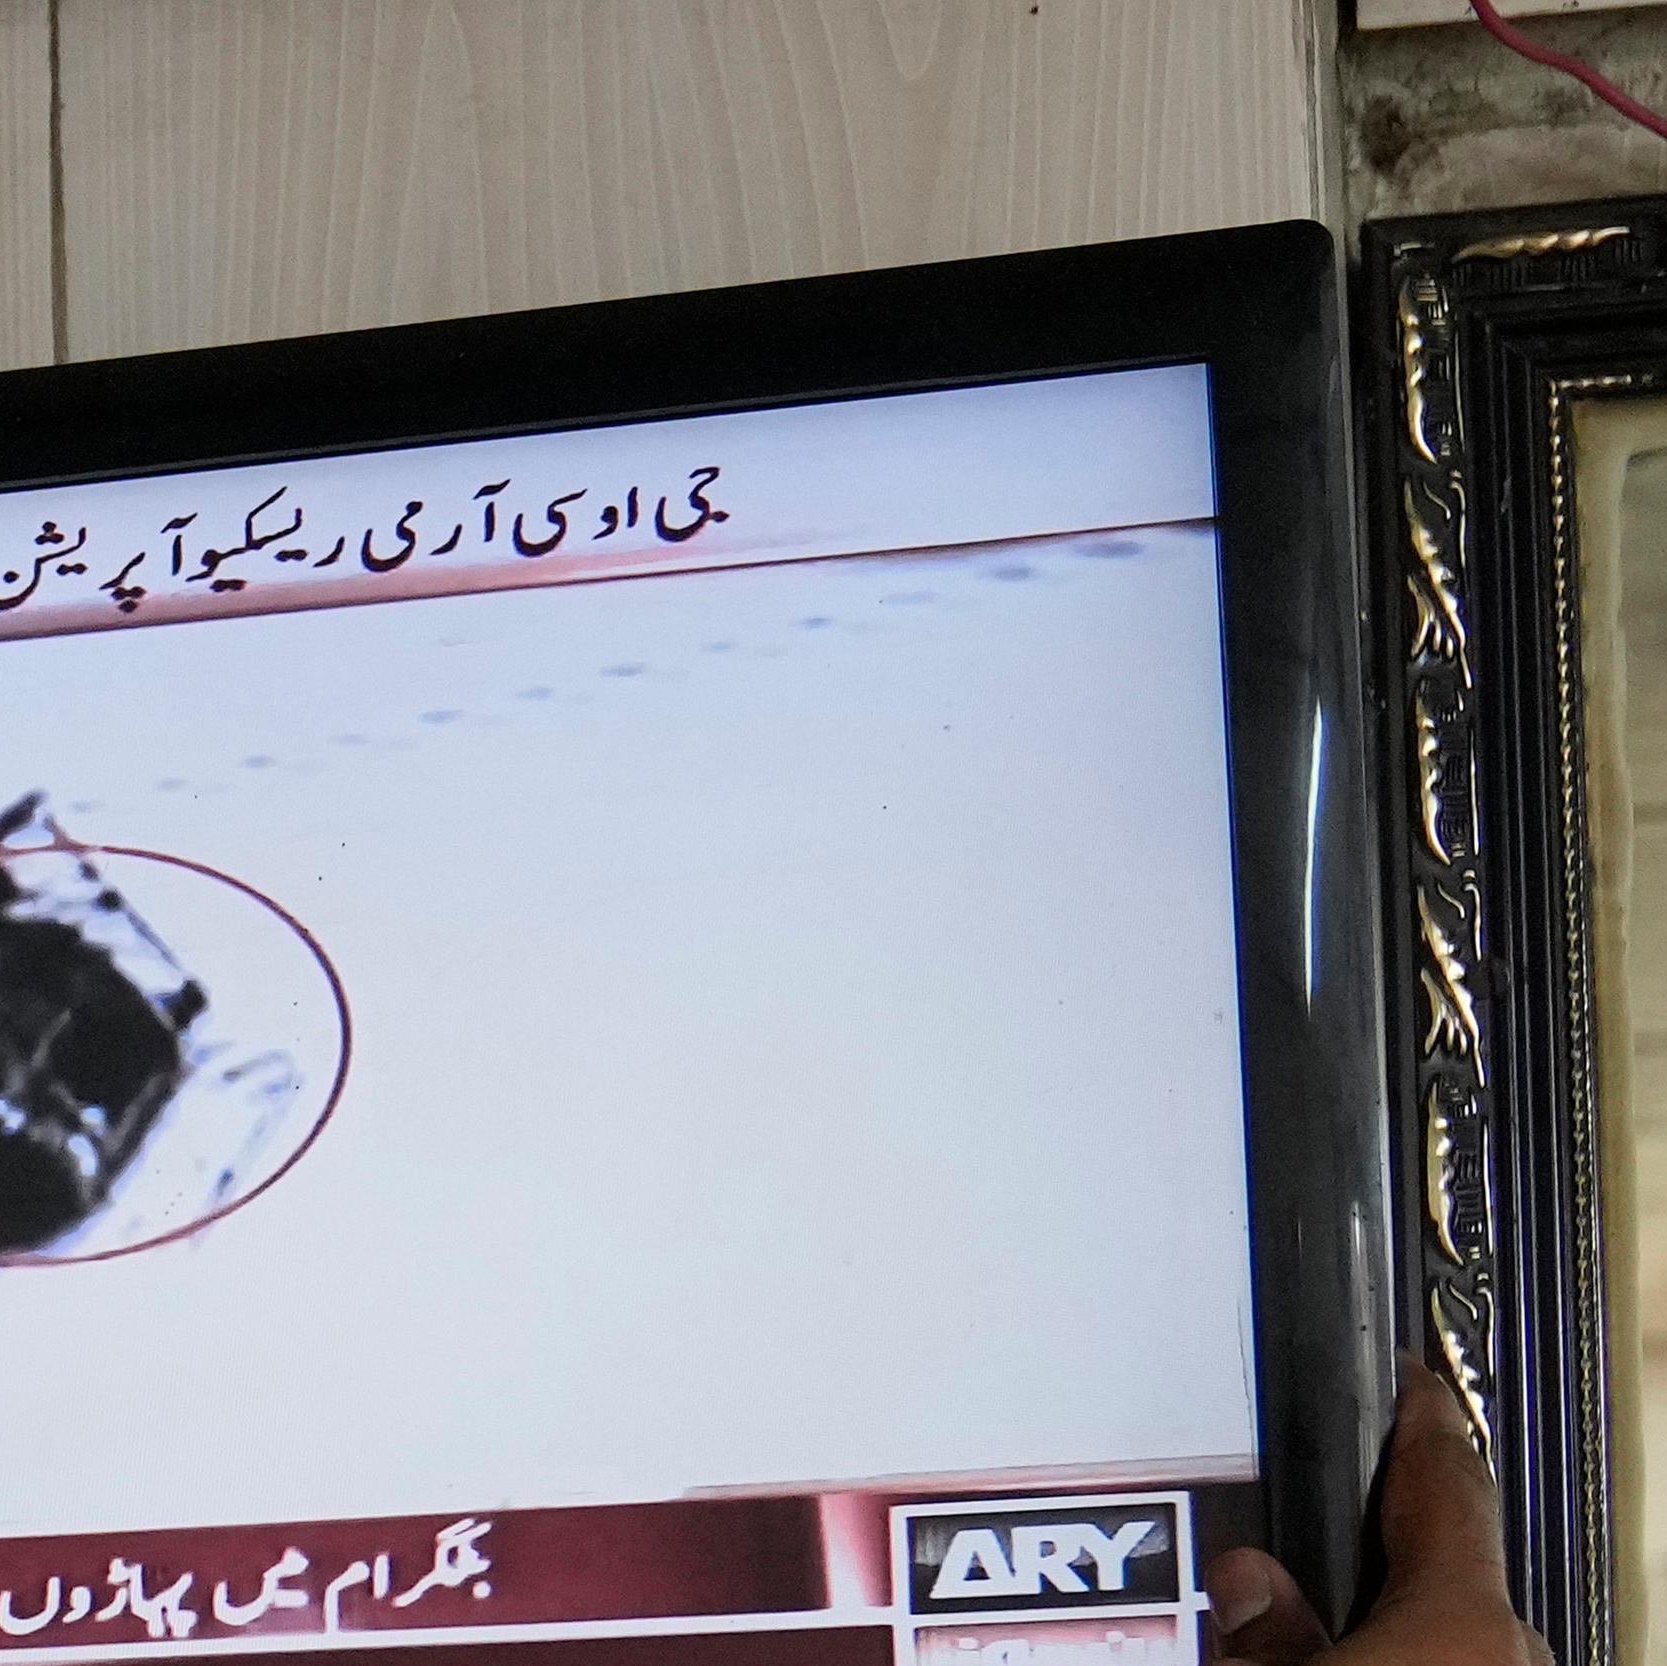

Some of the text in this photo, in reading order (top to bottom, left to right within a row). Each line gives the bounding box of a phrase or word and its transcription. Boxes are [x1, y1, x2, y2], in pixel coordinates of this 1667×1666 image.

[359, 478, 511, 574] آرمی
[512, 488, 589, 558] سی
[591, 486, 640, 541] او
[653, 466, 731, 544] جی
[212, 1547, 310, 1627] میں
[929, 1520, 1155, 1599] ARY
